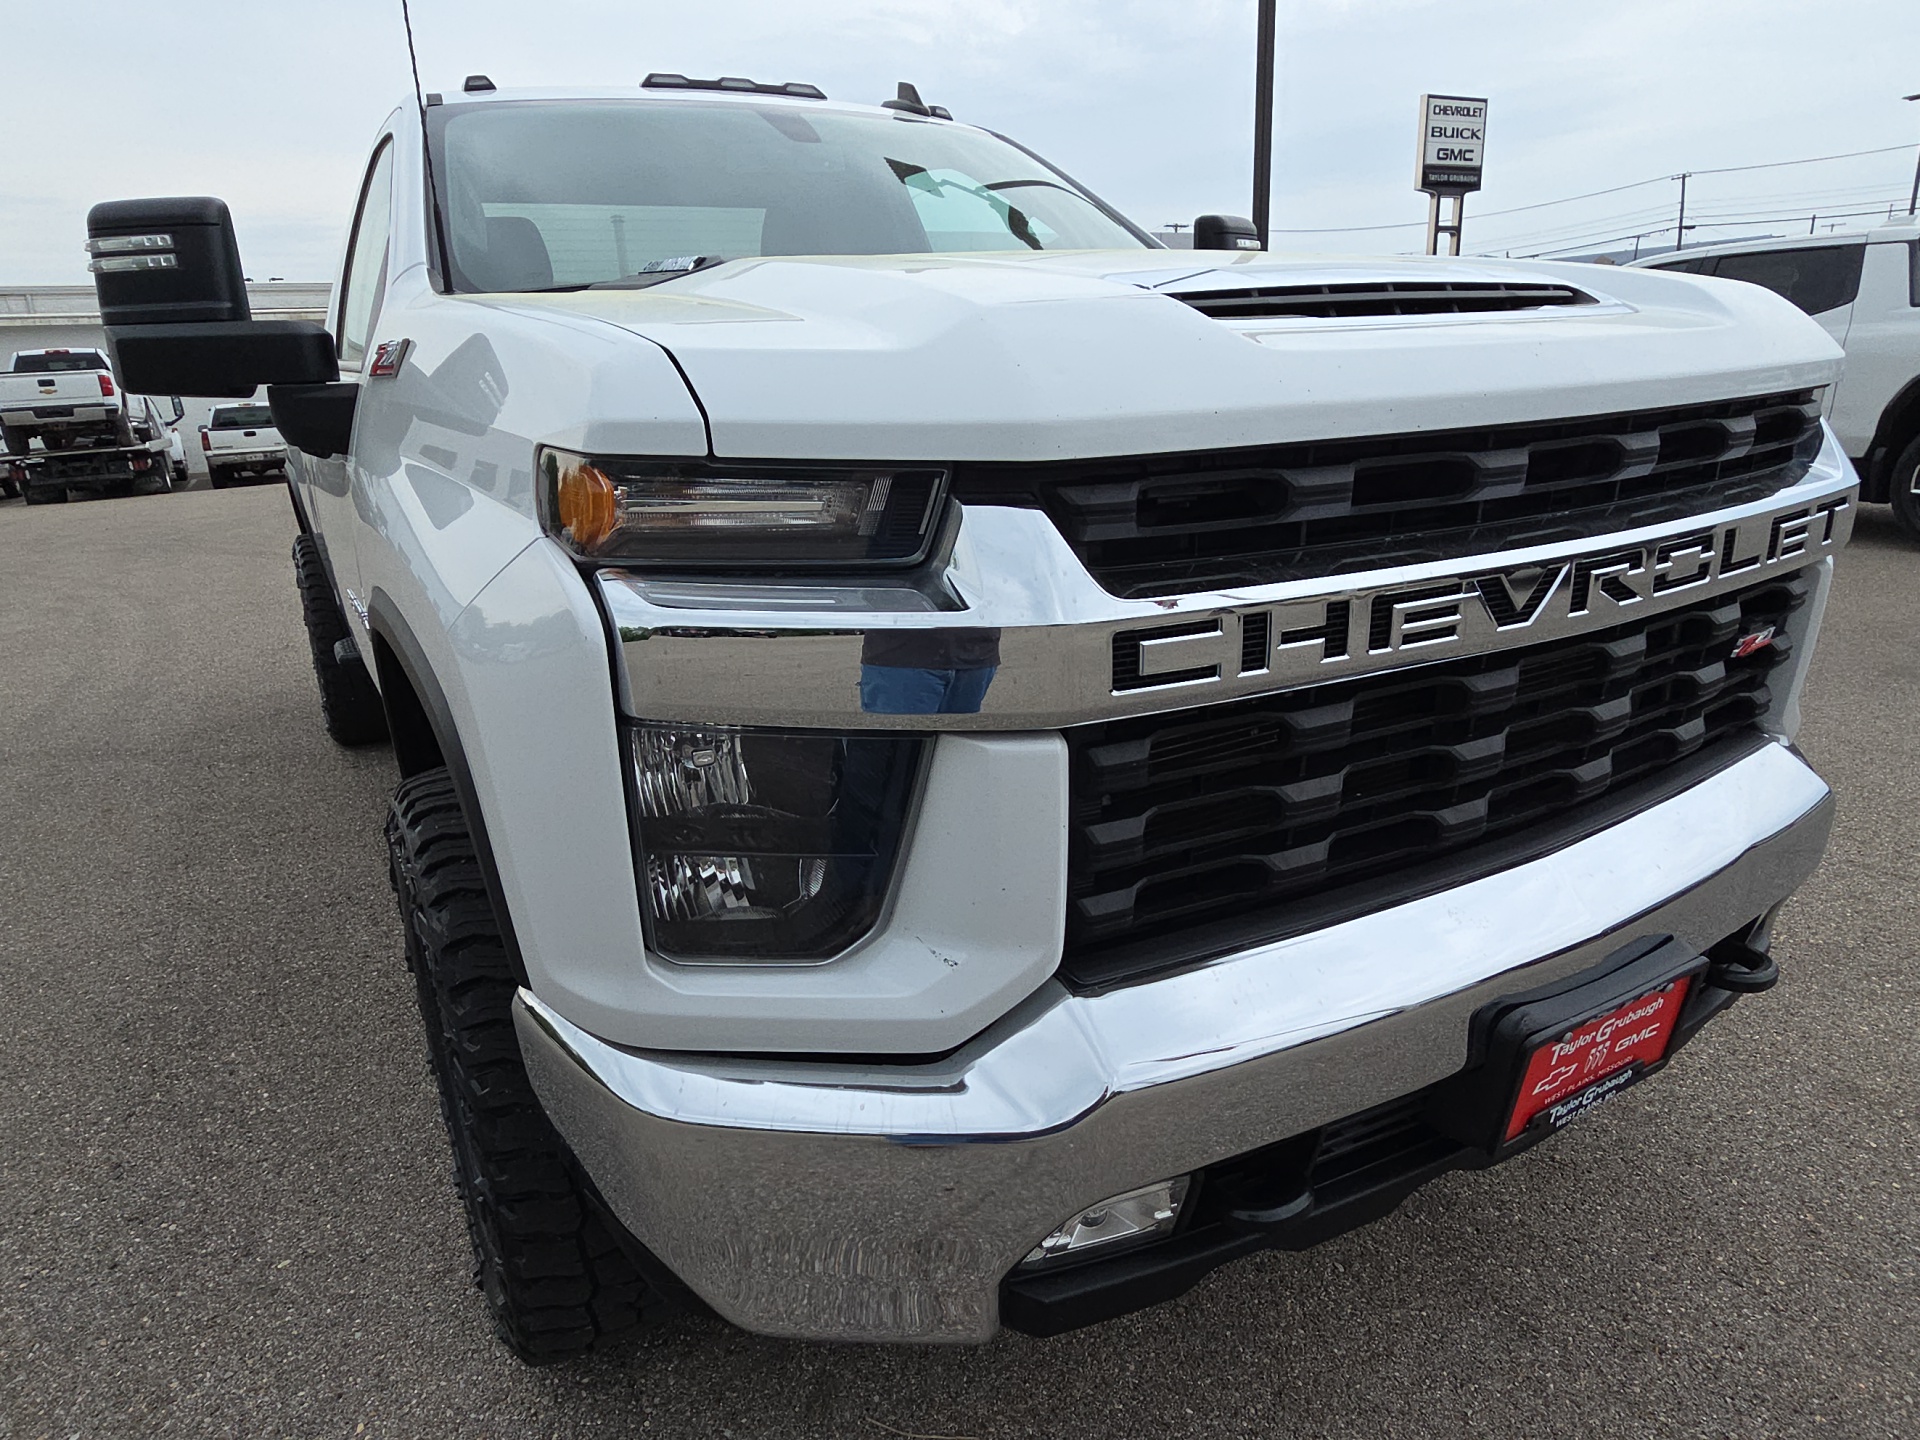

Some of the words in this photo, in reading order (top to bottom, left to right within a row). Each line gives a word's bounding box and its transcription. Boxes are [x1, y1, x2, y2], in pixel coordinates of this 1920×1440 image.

[1433, 104, 1483, 118] CHEVROLET
[1431, 126, 1481, 140] BUICK
[1437, 148, 1474, 161] GMC
[1110, 501, 1850, 696] CHEVROLET
[1551, 1032, 1596, 1065] Taylor
[1596, 997, 1664, 1042] Grubaugh
[1615, 1023, 1660, 1052] GMC
[1545, 1090, 1567, 1105] WEST
[1549, 1098, 1583, 1123] Taylor
[1583, 1069, 1632, 1105] Grubaugh
[1556, 1112, 1578, 1127] WEST
